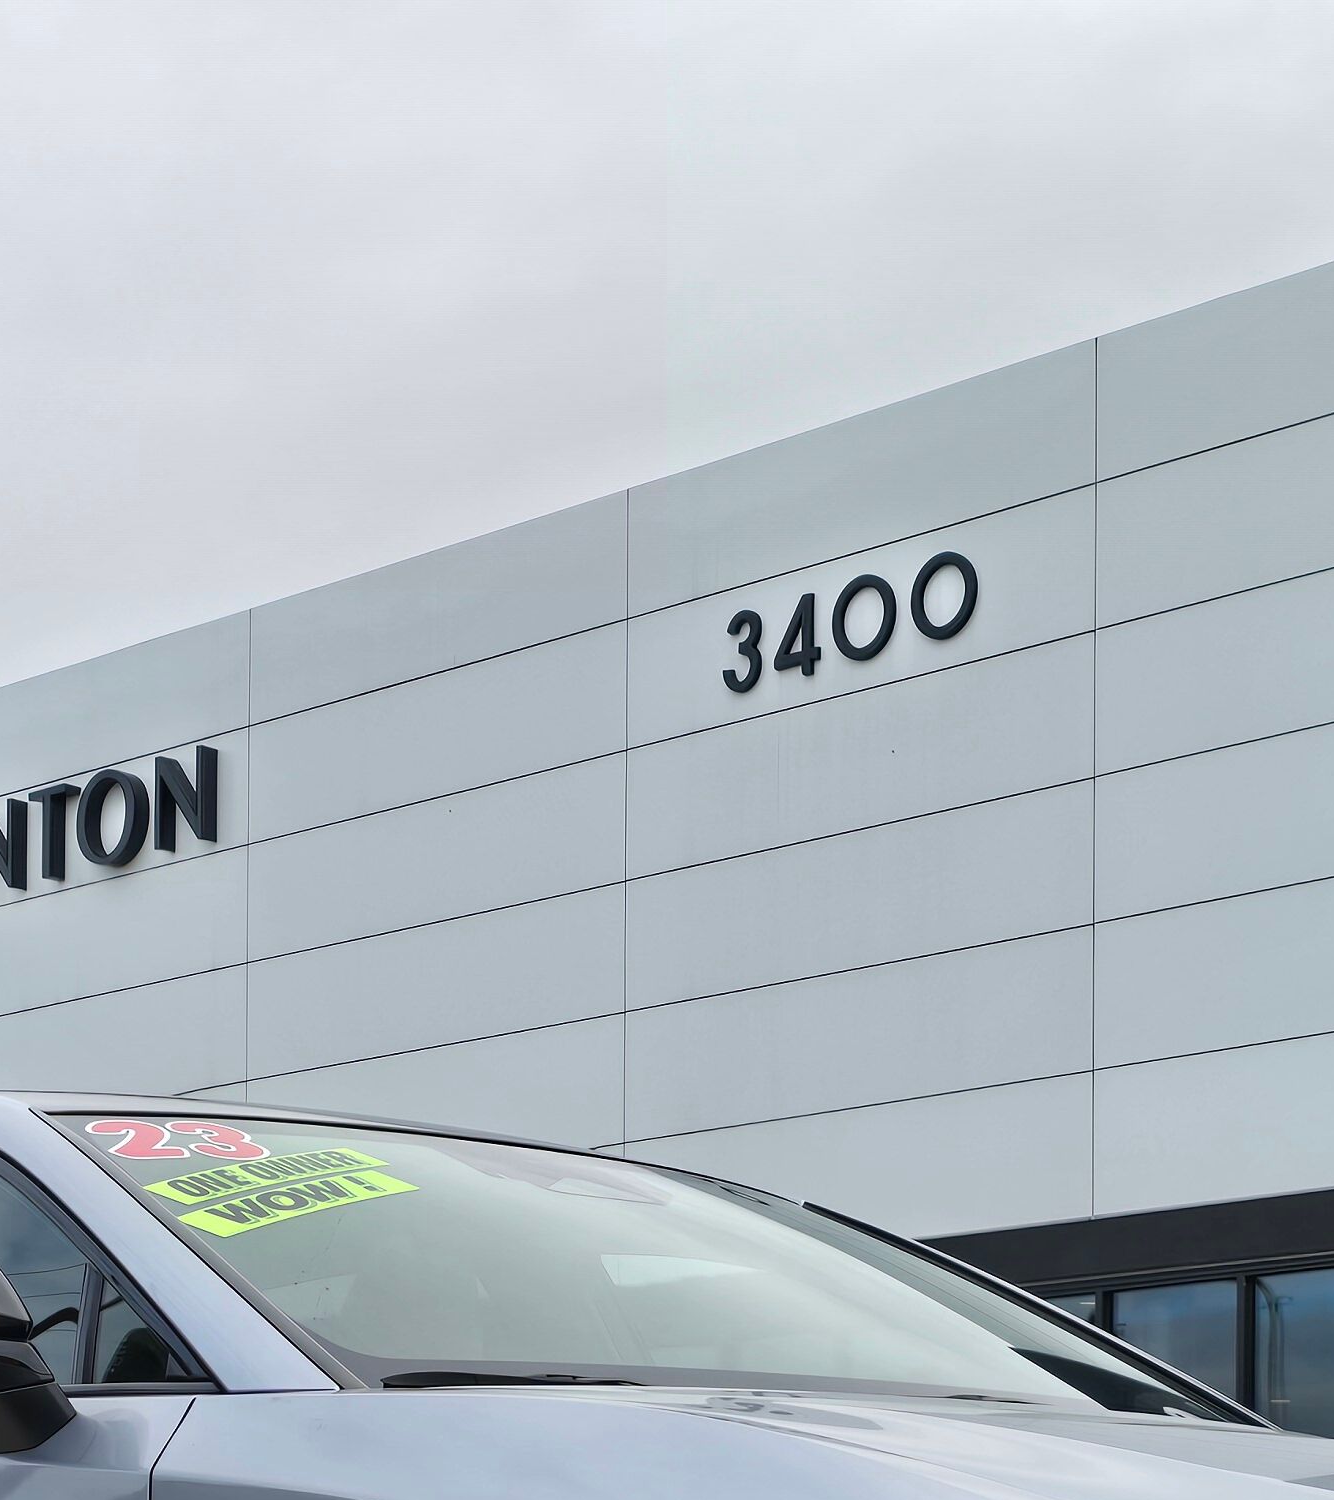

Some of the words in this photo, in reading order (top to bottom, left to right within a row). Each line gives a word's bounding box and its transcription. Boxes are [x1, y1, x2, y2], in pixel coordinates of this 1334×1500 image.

[722, 550, 979, 694] 3400
[85, 1119, 271, 1161] 23
[166, 1168, 260, 1198] ONE
[238, 1149, 369, 1182] OWNER
